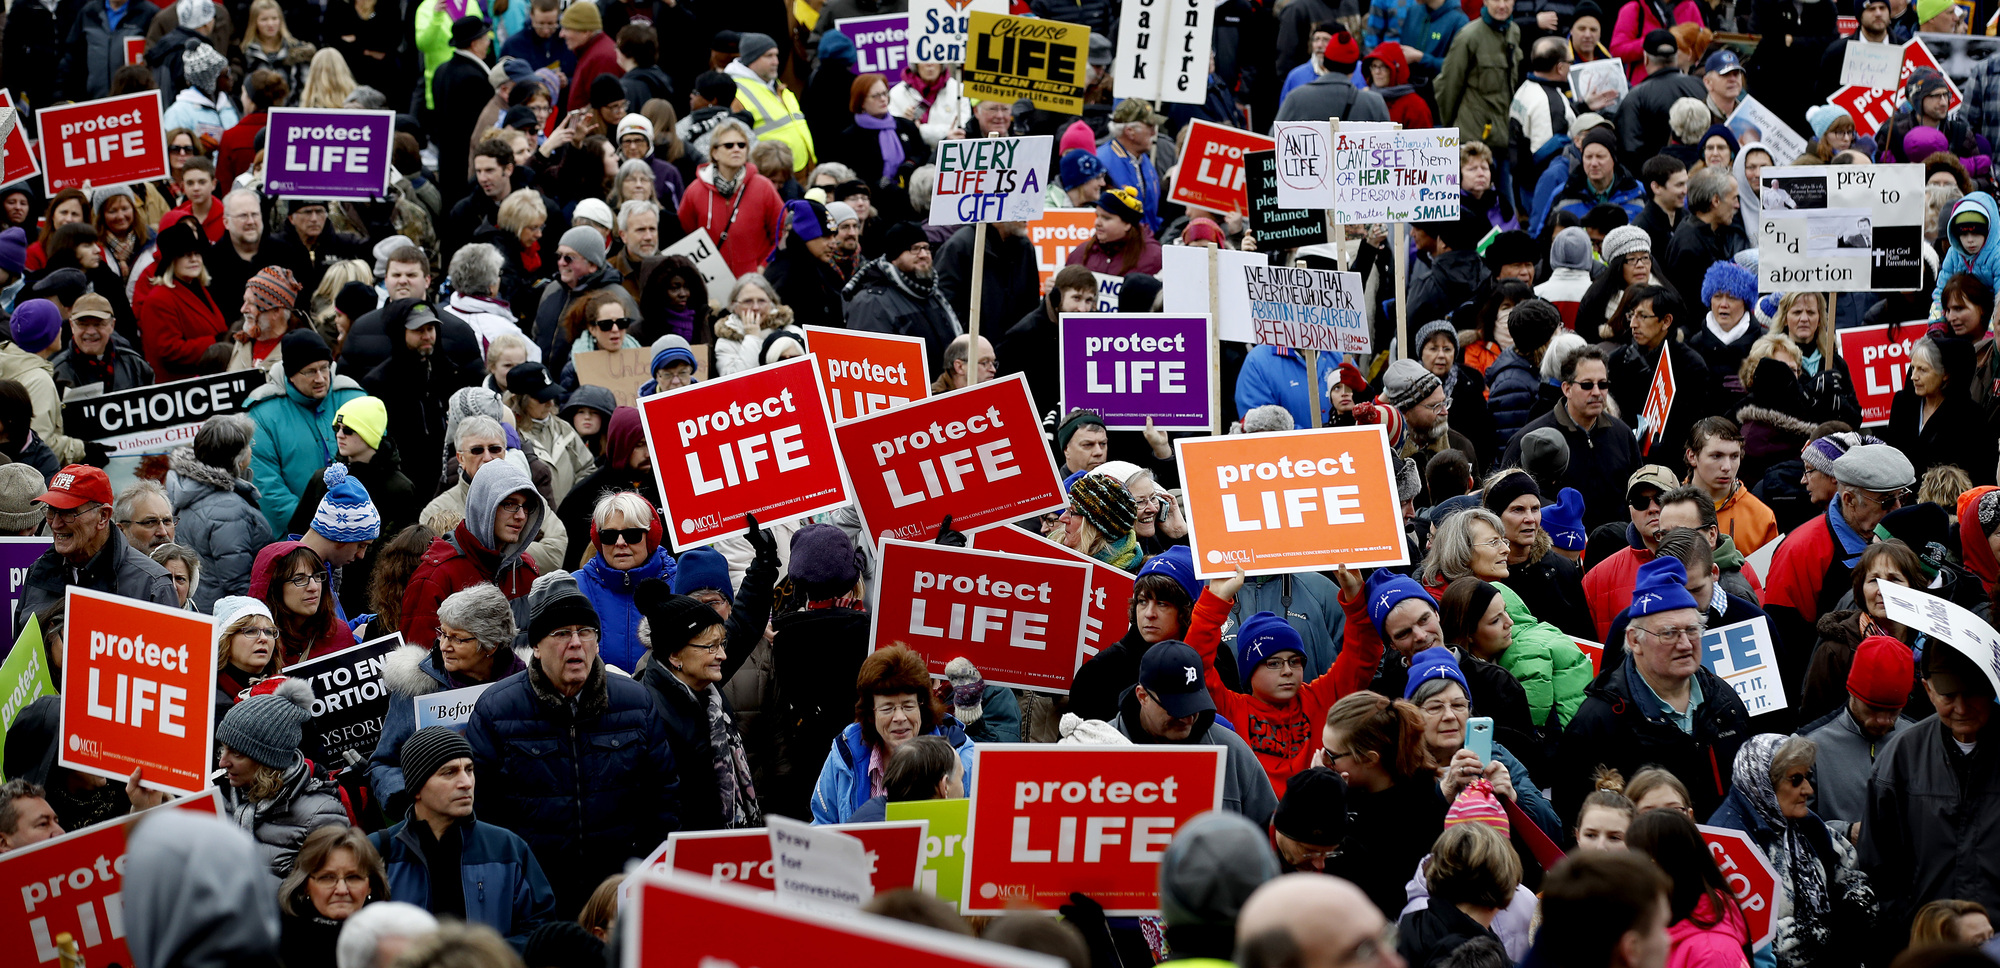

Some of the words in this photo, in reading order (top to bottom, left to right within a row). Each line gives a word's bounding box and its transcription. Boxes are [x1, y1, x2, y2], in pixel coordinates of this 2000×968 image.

[991, 18, 1067, 39] Choose
[857, 45, 908, 73] LIF
[976, 32, 1077, 84] LIFE
[974, 72, 997, 83] WE
[999, 76, 1030, 88] CAN
[1033, 81, 1077, 95] HELP!
[61, 109, 142, 140] protect
[288, 124, 371, 143] protect
[63, 130, 145, 168] LIFE
[940, 139, 1020, 172] EVERY
[1284, 134, 1320, 156] ANTI
[1336, 135, 1365, 150] And
[1369, 136, 1392, 149] Even
[1393, 137, 1432, 149] though
[285, 145, 370, 173] LIFE
[1285, 158, 1319, 177] LIFE
[1371, 149, 1406, 168] SEE
[1407, 148, 1452, 167] Them
[937, 170, 987, 195] LIFE
[994, 169, 1017, 194] IS
[1021, 168, 1039, 193] A
[1336, 172, 1355, 186] OR
[1359, 169, 1390, 186] HEAR
[1394, 169, 1428, 186] THEM
[1430, 174, 1444, 186] AT
[1837, 170, 1875, 189] pray
[957, 193, 1009, 222] GIFT
[1419, 188, 1460, 201] Person
[1880, 189, 1900, 204] to
[1263, 209, 1310, 223] Planned
[1386, 206, 1409, 220] how
[1413, 205, 1459, 221] SMALL!
[1257, 222, 1321, 242] Parenthood
[1764, 221, 1800, 254] end
[1034, 245, 1077, 272] LI
[1268, 266, 1313, 288] NOTICED
[1313, 270, 1344, 290] THAT
[1770, 264, 1853, 282] abortion
[1247, 282, 1301, 305] EVERYONE
[1335, 290, 1355, 309] FOR
[1252, 300, 1294, 322] ABORTION
[1296, 305, 1319, 325] HAS
[1320, 307, 1362, 329] ALREADY
[1085, 332, 1185, 357] protect
[1254, 318, 1296, 348] BEEN
[1299, 322, 1338, 350] BORN
[1863, 342, 1912, 365] prot
[827, 357, 908, 386] protect
[1086, 360, 1187, 393] LIFE
[83, 379, 246, 432] "CHOICE"
[677, 386, 796, 448] protect
[118, 434, 162, 451] Unborn
[872, 404, 1005, 466] protect
[685, 423, 811, 496] LIFE
[1216, 451, 1356, 489] protect
[53, 478, 72, 488] LIFE
[882, 437, 1022, 509] LIFE
[693, 514, 719, 530] MCCL
[1221, 485, 1365, 533] LIFE
[894, 523, 921, 538] MCCL
[1222, 550, 1250, 562] MCCL
[913, 570, 1052, 604] protect
[909, 597, 1049, 651] LIFE
[90, 630, 189, 674] protect
[1, 646, 40, 733] protect
[317, 667, 351, 691] TO
[1751, 676, 1767, 692] IT,
[87, 667, 187, 739] LIFE
[1755, 695, 1771, 709] IT.
[80, 738, 98, 754] MCCL
[1014, 775, 1178, 810] protect
[776, 828, 811, 851] Pray
[1010, 816, 1175, 863] LIFE
[781, 853, 802, 869] for
[783, 876, 860, 904] conversion
[998, 885, 1028, 897] MCCL
